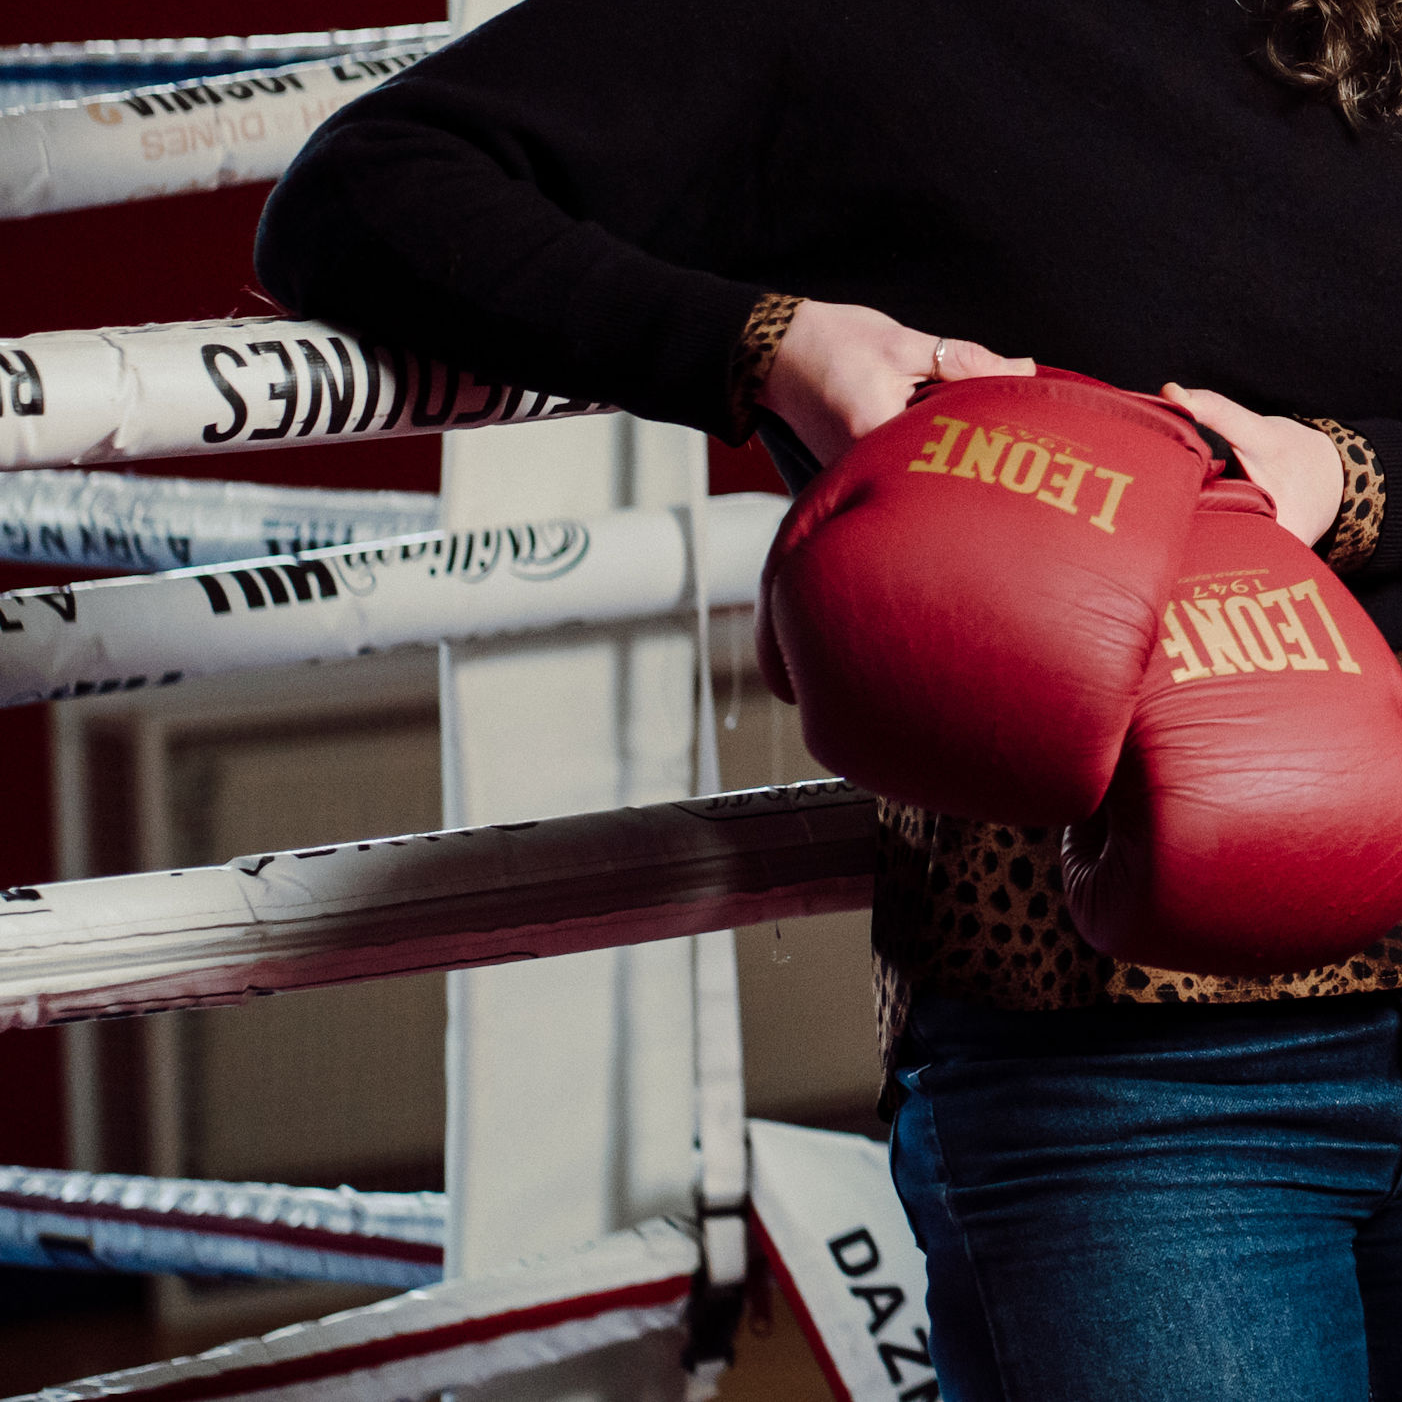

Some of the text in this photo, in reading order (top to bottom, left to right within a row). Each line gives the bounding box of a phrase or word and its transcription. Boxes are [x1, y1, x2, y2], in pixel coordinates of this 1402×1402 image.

[906, 414, 1135, 535] LEONE
[1160, 578, 1362, 684] LEONE
[1192, 578, 1269, 599] 1947
